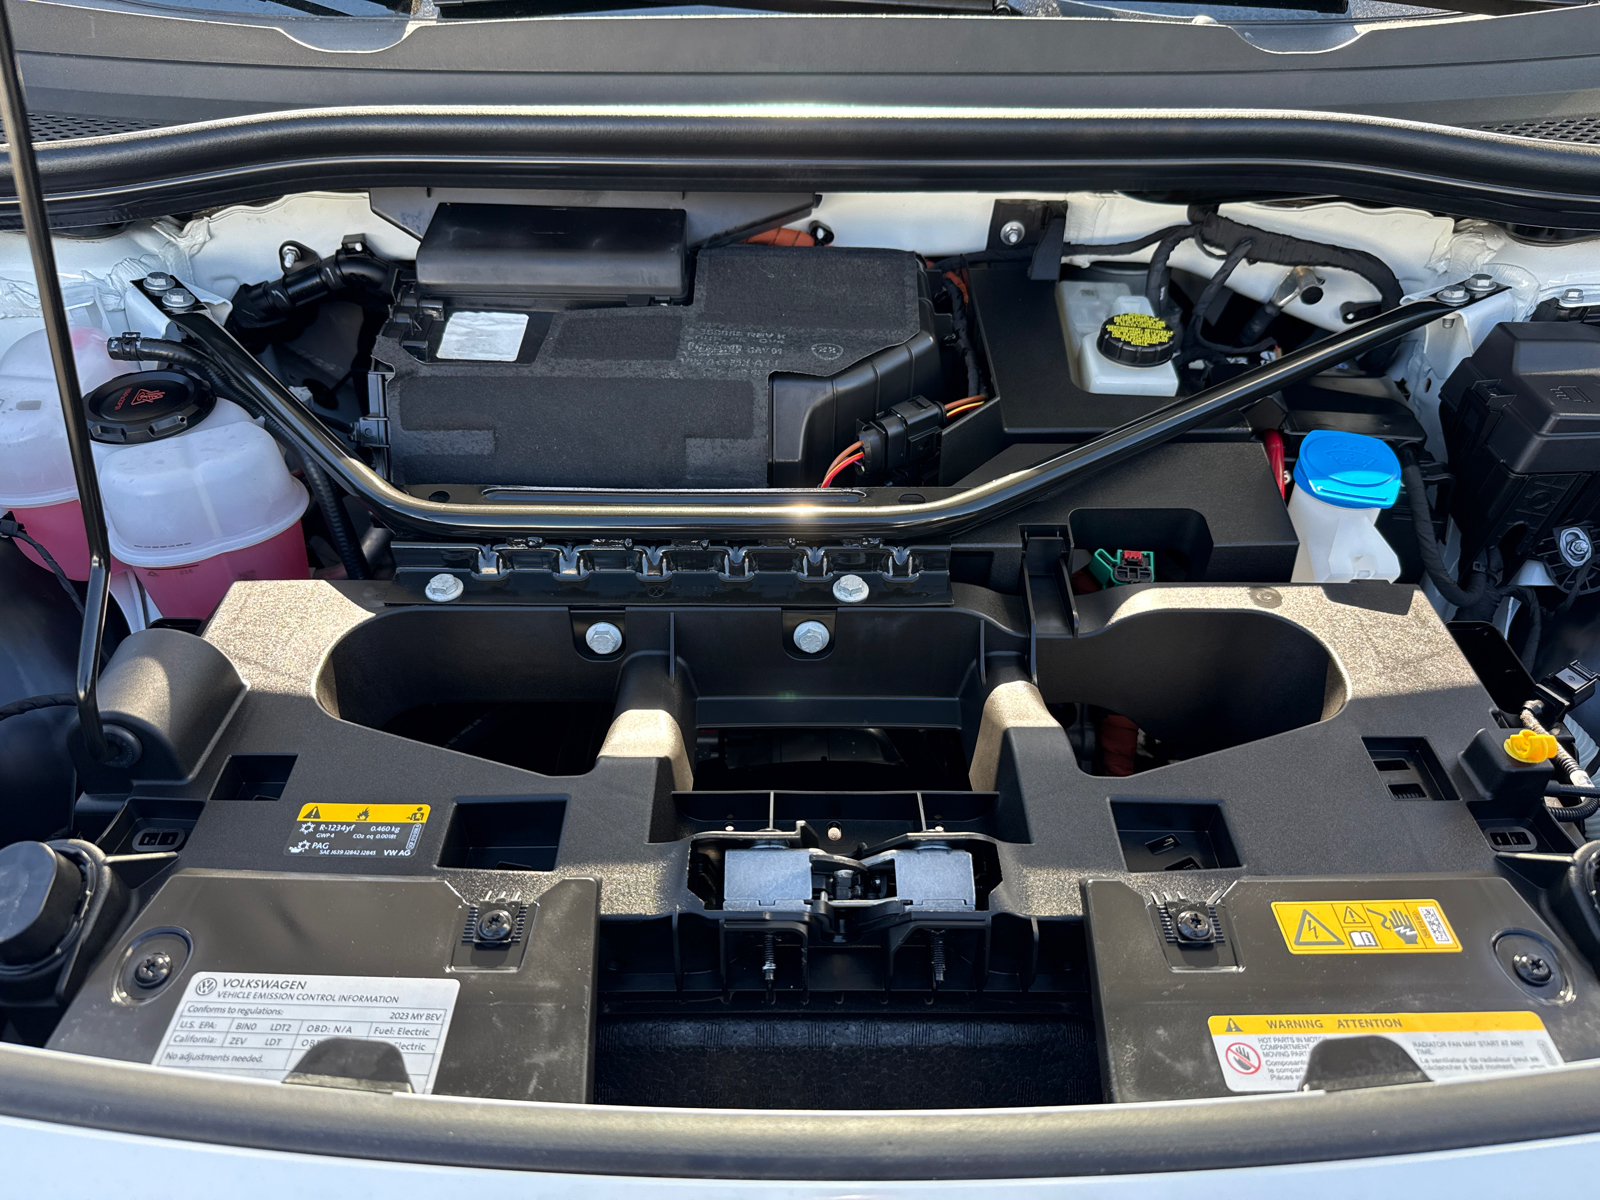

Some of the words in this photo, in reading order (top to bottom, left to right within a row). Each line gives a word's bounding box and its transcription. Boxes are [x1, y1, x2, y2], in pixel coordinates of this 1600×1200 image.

[319, 824, 356, 833] R-1234yf
[222, 979, 307, 990] VOLKSWAGEN
[217, 991, 252, 999] VEHICLE
[252, 992, 295, 1000] EMISSION
[296, 993, 336, 1002] CONTROL
[338, 994, 400, 1004] INFORMATION
[187, 1004, 226, 1014] Conforms
[227, 1006, 236, 1014] to
[237, 1006, 284, 1016] regulations:
[390, 1012, 410, 1020] 2023
[410, 1012, 425, 1021] MY
[425, 1013, 442, 1021] BEV
[180, 1021, 196, 1029] U.S.
[270, 1024, 292, 1032] LDT2
[1266, 1019, 1324, 1029] WARNING
[1337, 1018, 1403, 1029] ATTENTION
[306, 1025, 330, 1033] OBD:
[333, 1025, 352, 1034] N/A
[373, 1026, 394, 1036] Fuel:
[397, 1027, 430, 1036] Electric
[173, 1034, 217, 1044] California:
[264, 1038, 282, 1046] LDT
[1258, 1036, 1272, 1044] HOT
[1272, 1036, 1295, 1044] PARTS
[1412, 1040, 1446, 1048] RADIATOR
[1448, 1040, 1462, 1048] FAN
[1464, 1040, 1477, 1048] MAY
[1478, 1040, 1500, 1048] START
[164, 1052, 178, 1060] No
[178, 1052, 230, 1062] adjustments
[231, 1054, 263, 1063] needed.
[1262, 1050, 1290, 1058] MOVING
